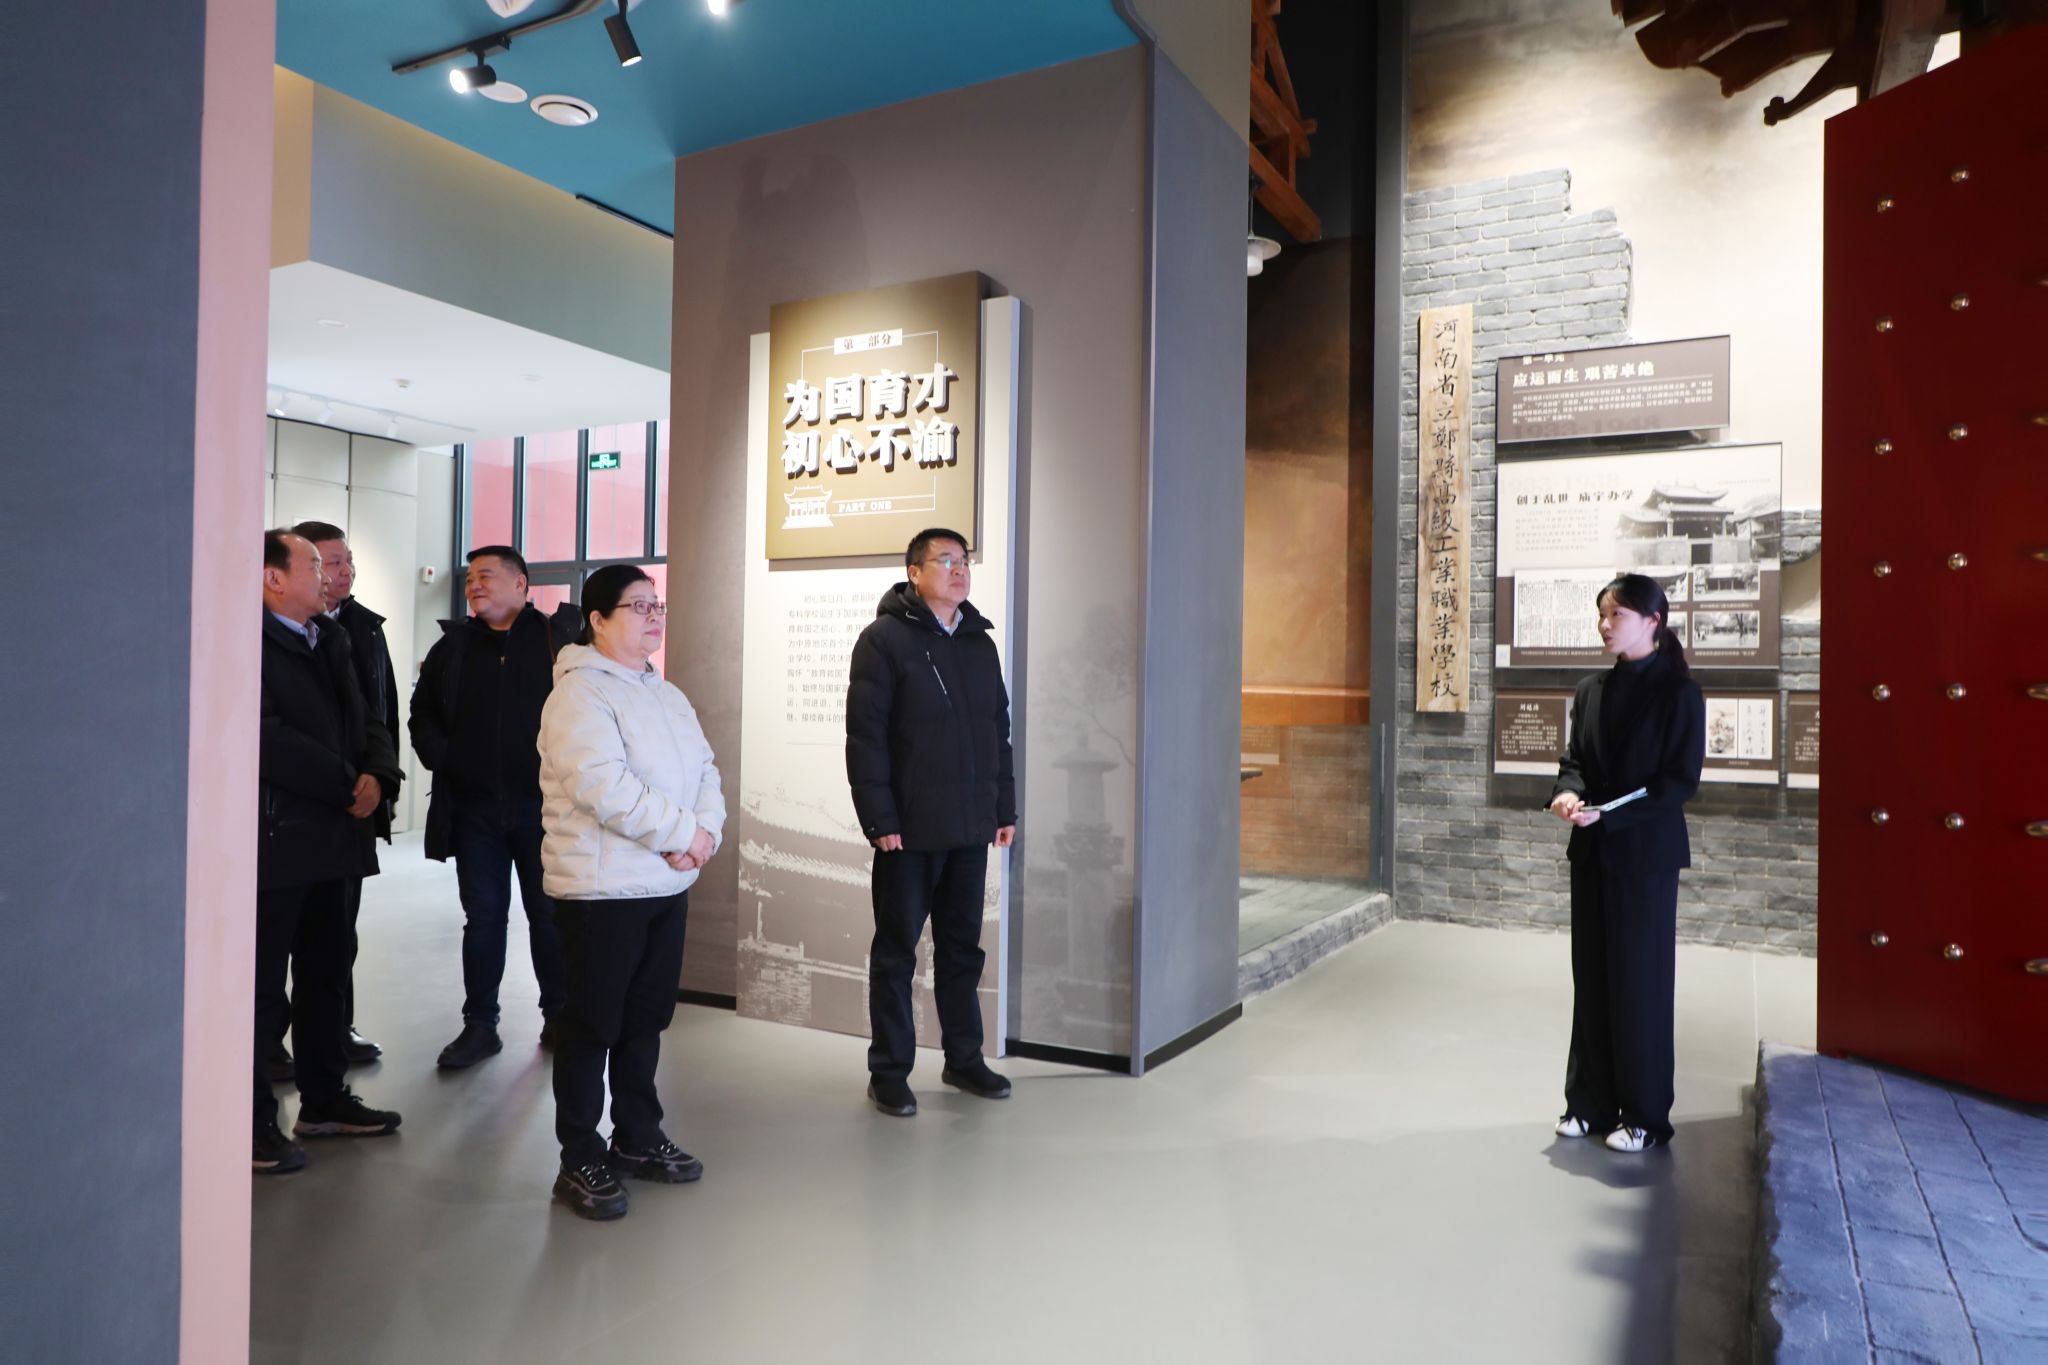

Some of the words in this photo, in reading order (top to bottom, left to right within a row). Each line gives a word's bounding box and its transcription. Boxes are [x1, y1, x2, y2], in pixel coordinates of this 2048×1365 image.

[844, 332, 892, 350] 第一部分
[1512, 367, 1580, 388] 应运而生
[1584, 360, 1655, 382] 艰苦卓绝
[783, 362, 957, 426] 为国育才
[781, 415, 957, 477] 初心不渝
[838, 502, 866, 513] PART
[870, 500, 892, 511] ONE
